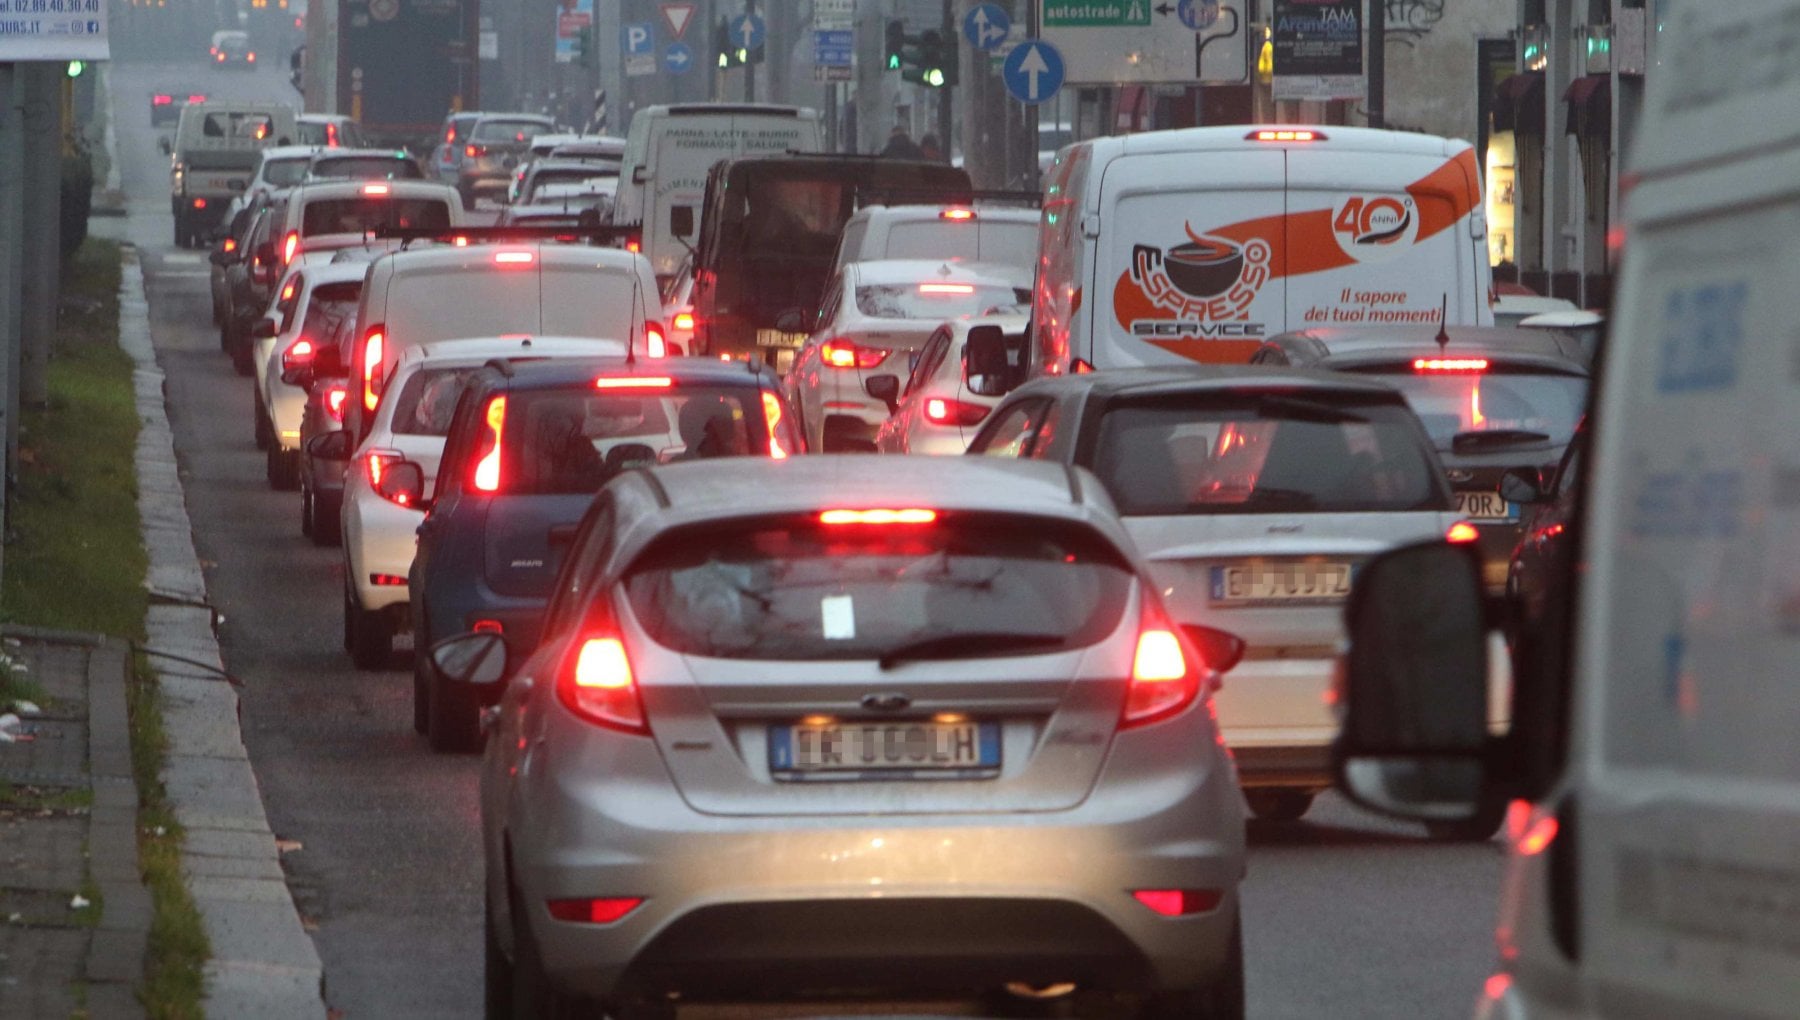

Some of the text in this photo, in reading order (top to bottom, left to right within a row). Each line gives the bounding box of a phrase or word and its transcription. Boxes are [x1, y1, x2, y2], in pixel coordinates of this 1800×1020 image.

[1047, 4, 1120, 18] autostrade
[1320, 7, 1354, 22] TAM
[628, 27, 646, 52] P
[666, 129, 799, 139] PANNA LATTE BURRO
[676, 139, 789, 149] FORMAGGI SALUMI
[1371, 215, 1397, 224] ANNI
[1132, 242, 1269, 321] ESPRESSO
[1340, 288, 1407, 306] Il sapore
[1304, 306, 1441, 322] dei tuoi momenti
[1133, 323, 1266, 336] SERVICE
